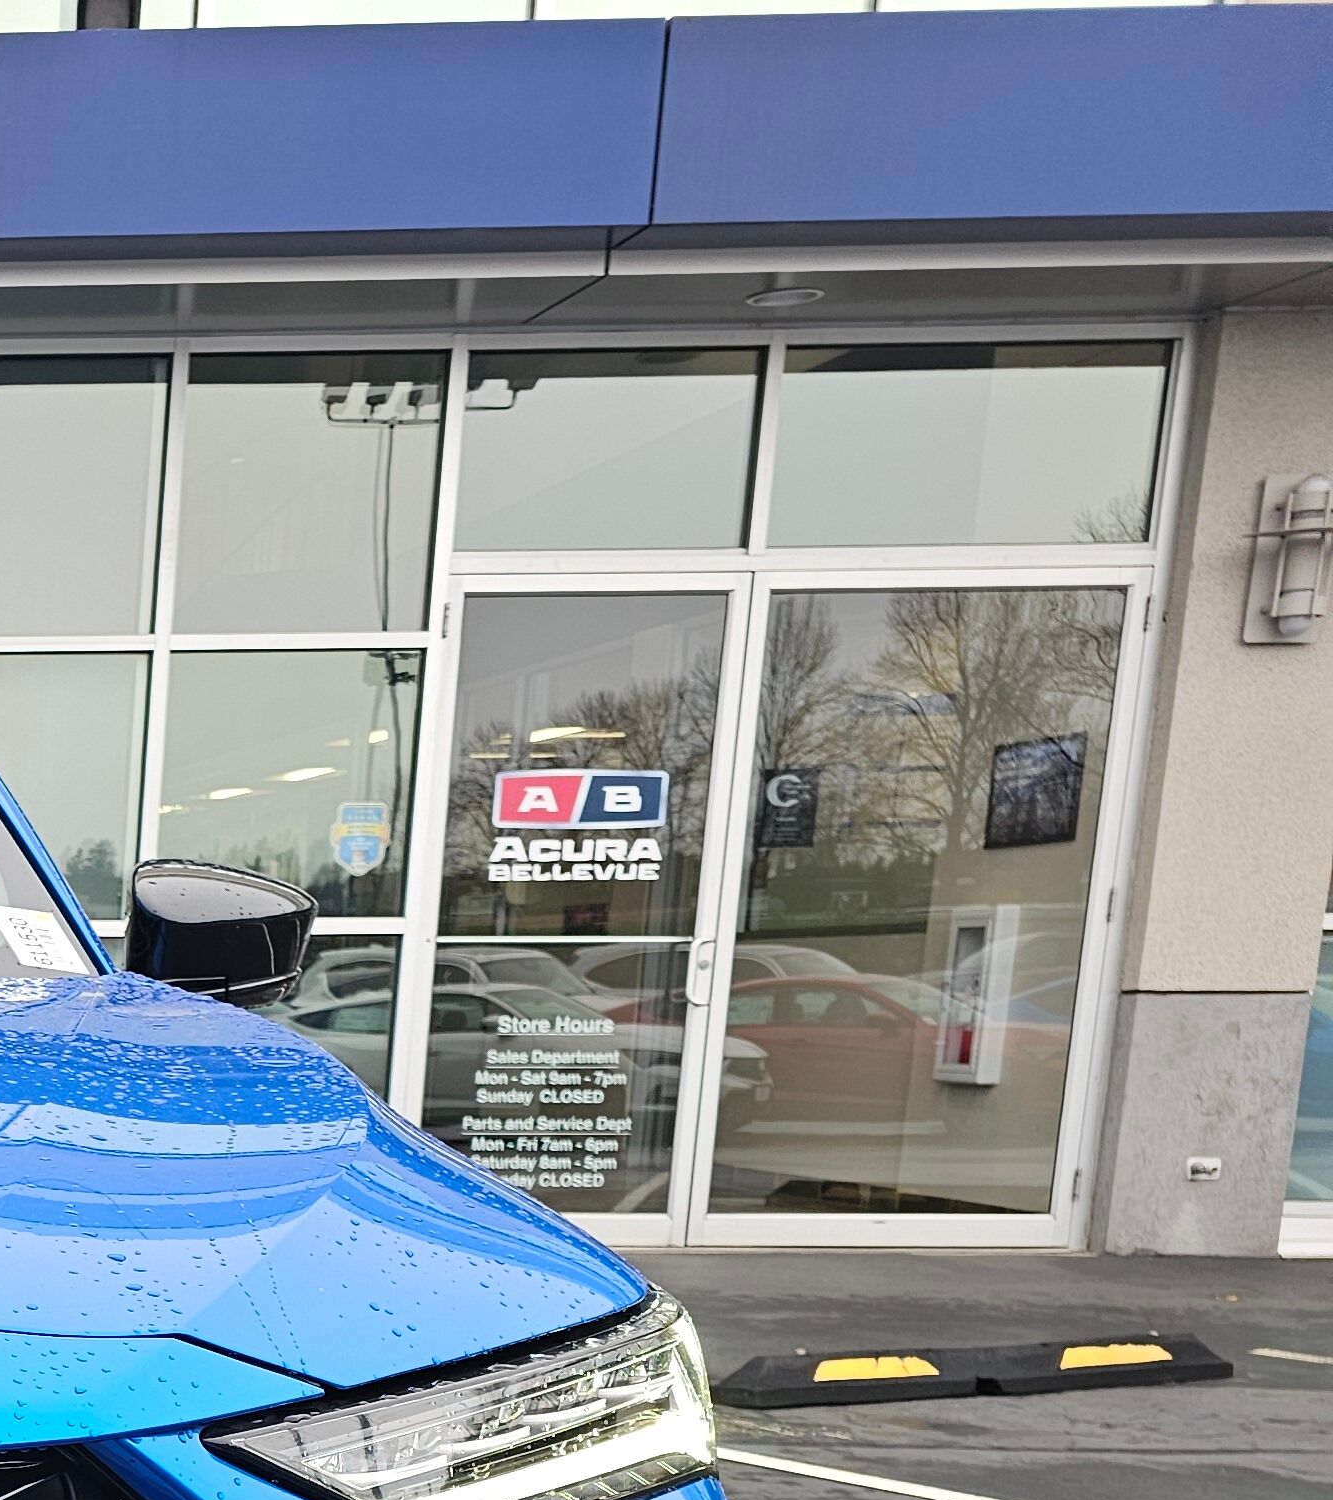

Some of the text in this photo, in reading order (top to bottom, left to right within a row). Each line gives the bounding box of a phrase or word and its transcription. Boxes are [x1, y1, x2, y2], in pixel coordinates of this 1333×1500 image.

[517, 785, 643, 813] A B
[488, 836, 663, 863] ACURA
[487, 863, 661, 882] BELLEVUE
[497, 1015, 615, 1034] Store Hours
[486, 1049, 620, 1067] Sales Department
[474, 1070, 509, 1086] Mon
[519, 1070, 547, 1085] Sat
[548, 1070, 582, 1086] 9am
[593, 1071, 627, 1088] 7pm
[476, 1088, 605, 1106] Sunday CLOSED
[461, 1115, 633, 1133] Parts and Service Dept
[471, 1136, 505, 1152] Mon
[516, 1136, 539, 1151] Fri
[540, 1136, 574, 1152] 7am
[584, 1137, 619, 1154] 6pm
[583, 1154, 618, 1173] 5pm
[538, 1172, 605, 1188] CLOSED
